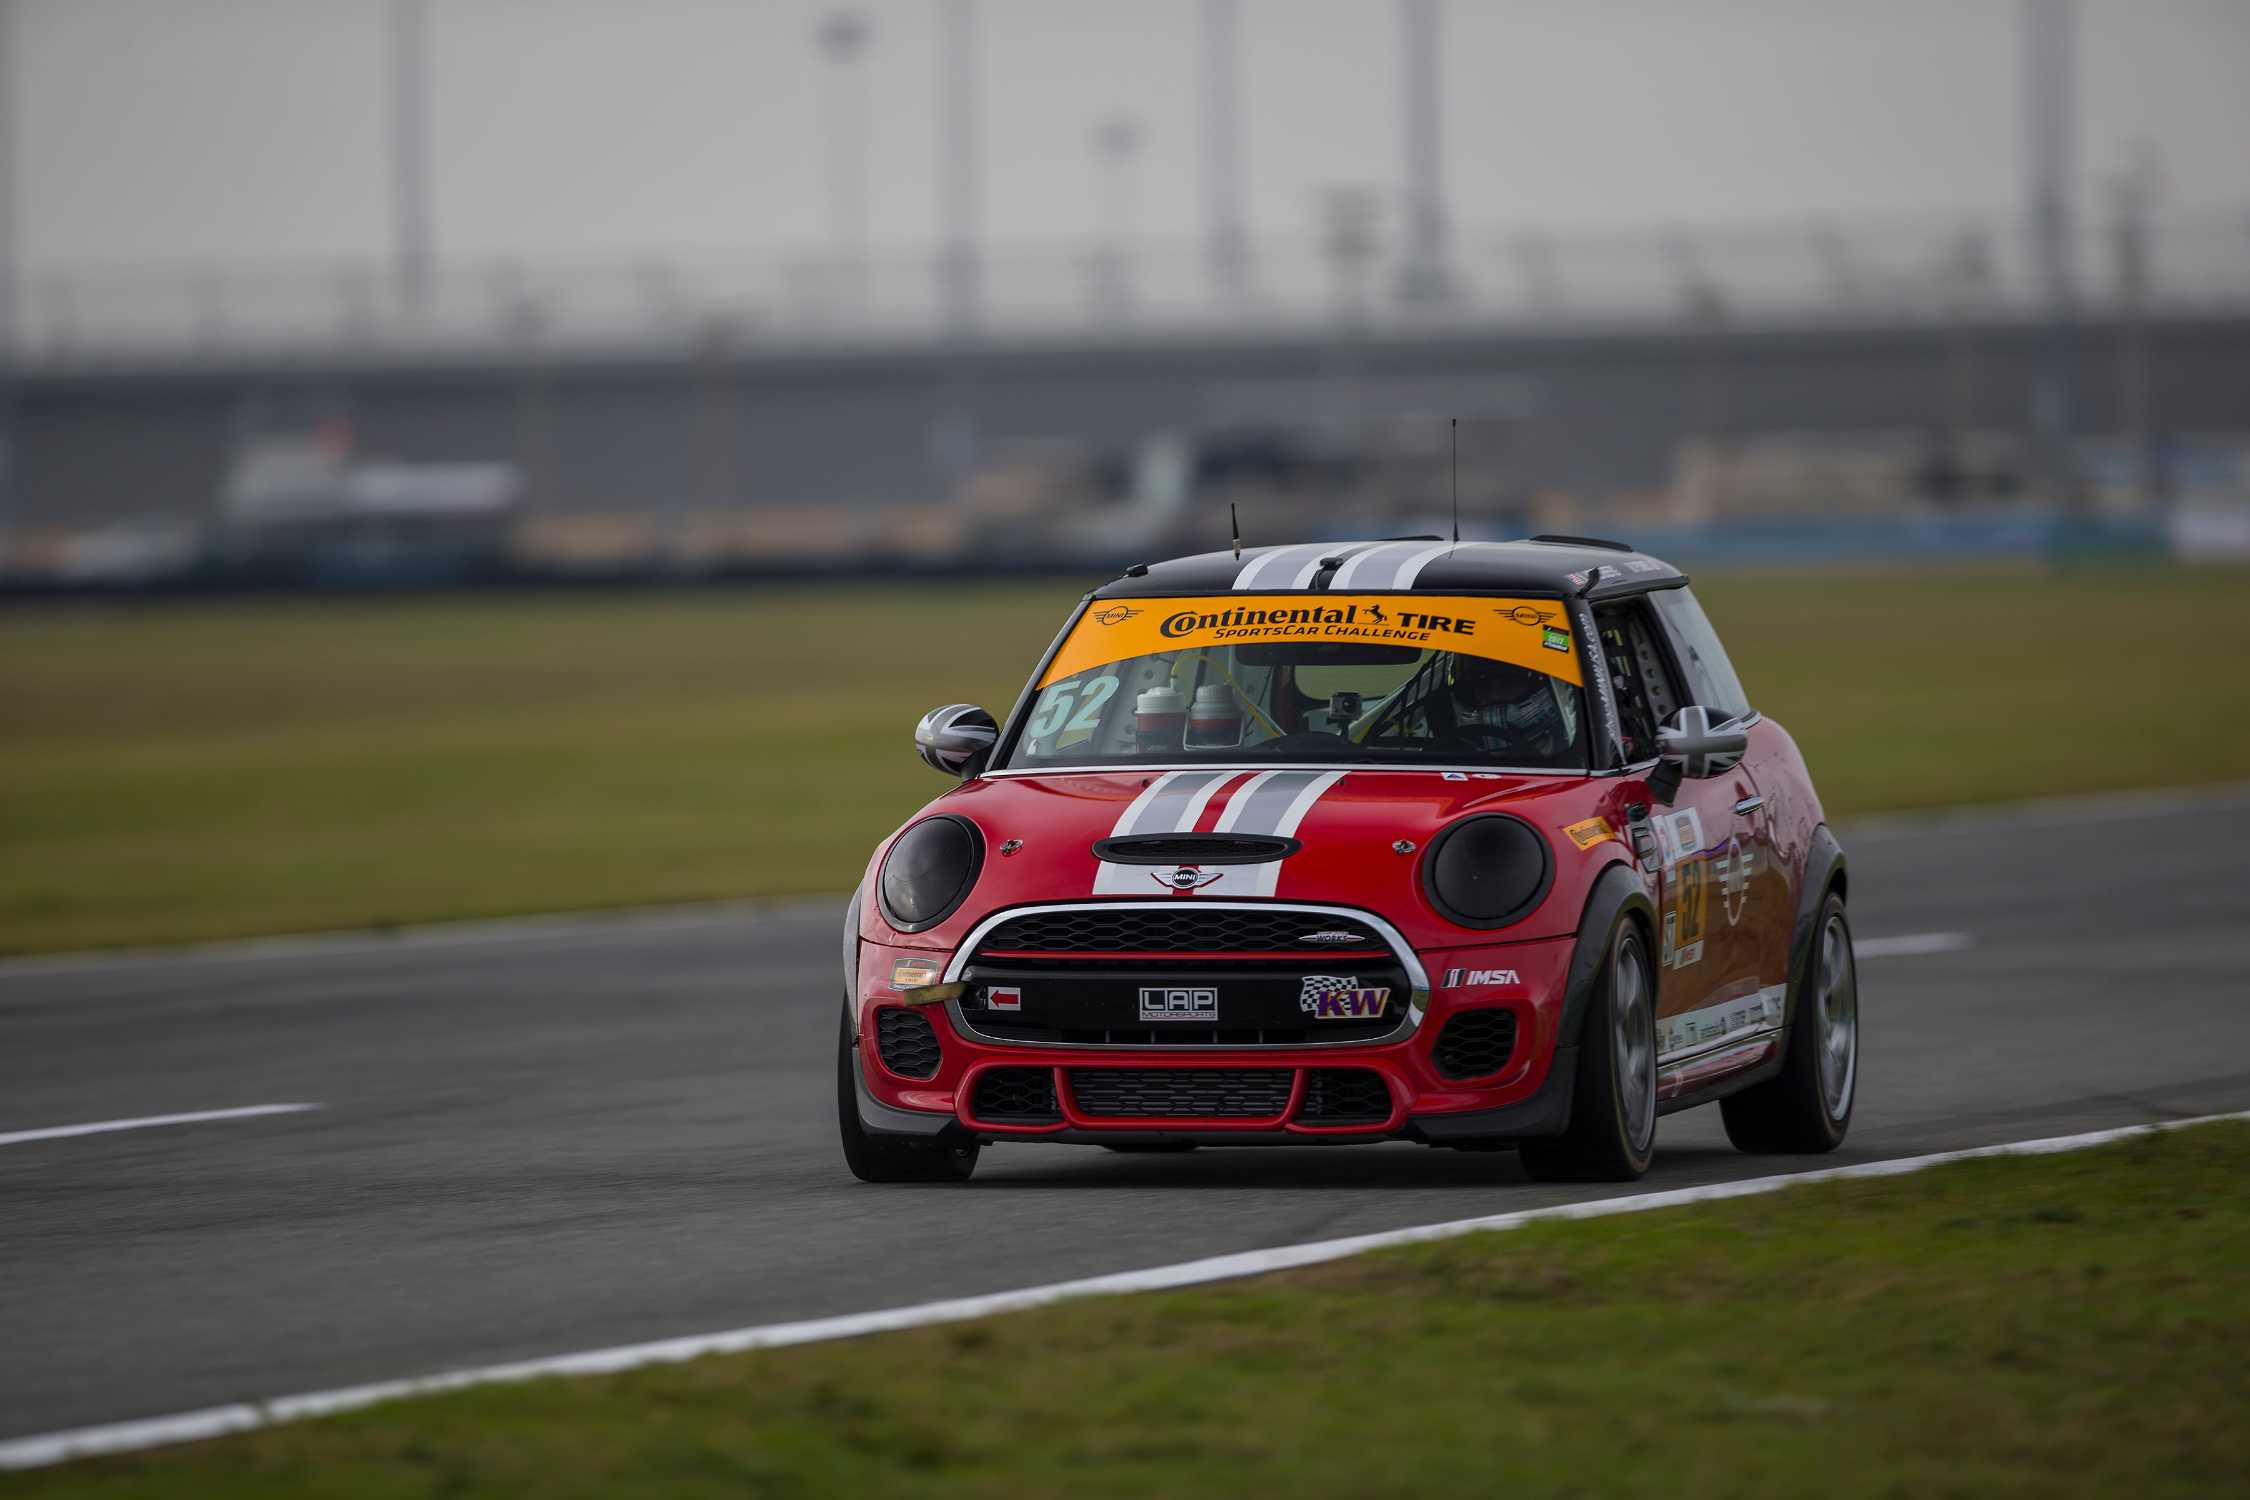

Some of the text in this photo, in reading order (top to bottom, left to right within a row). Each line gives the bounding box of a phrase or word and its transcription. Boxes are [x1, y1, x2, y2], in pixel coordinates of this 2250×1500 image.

[1160, 604, 1476, 639] Continental TIRE
[1324, 625, 1432, 641] CHALLENGE
[1030, 675, 1120, 738] 52
[1174, 873, 1197, 881] MINI
[1465, 969, 1521, 986] IMSA
[1143, 991, 1214, 1010] LAP
[1316, 988, 1389, 1018] KW
